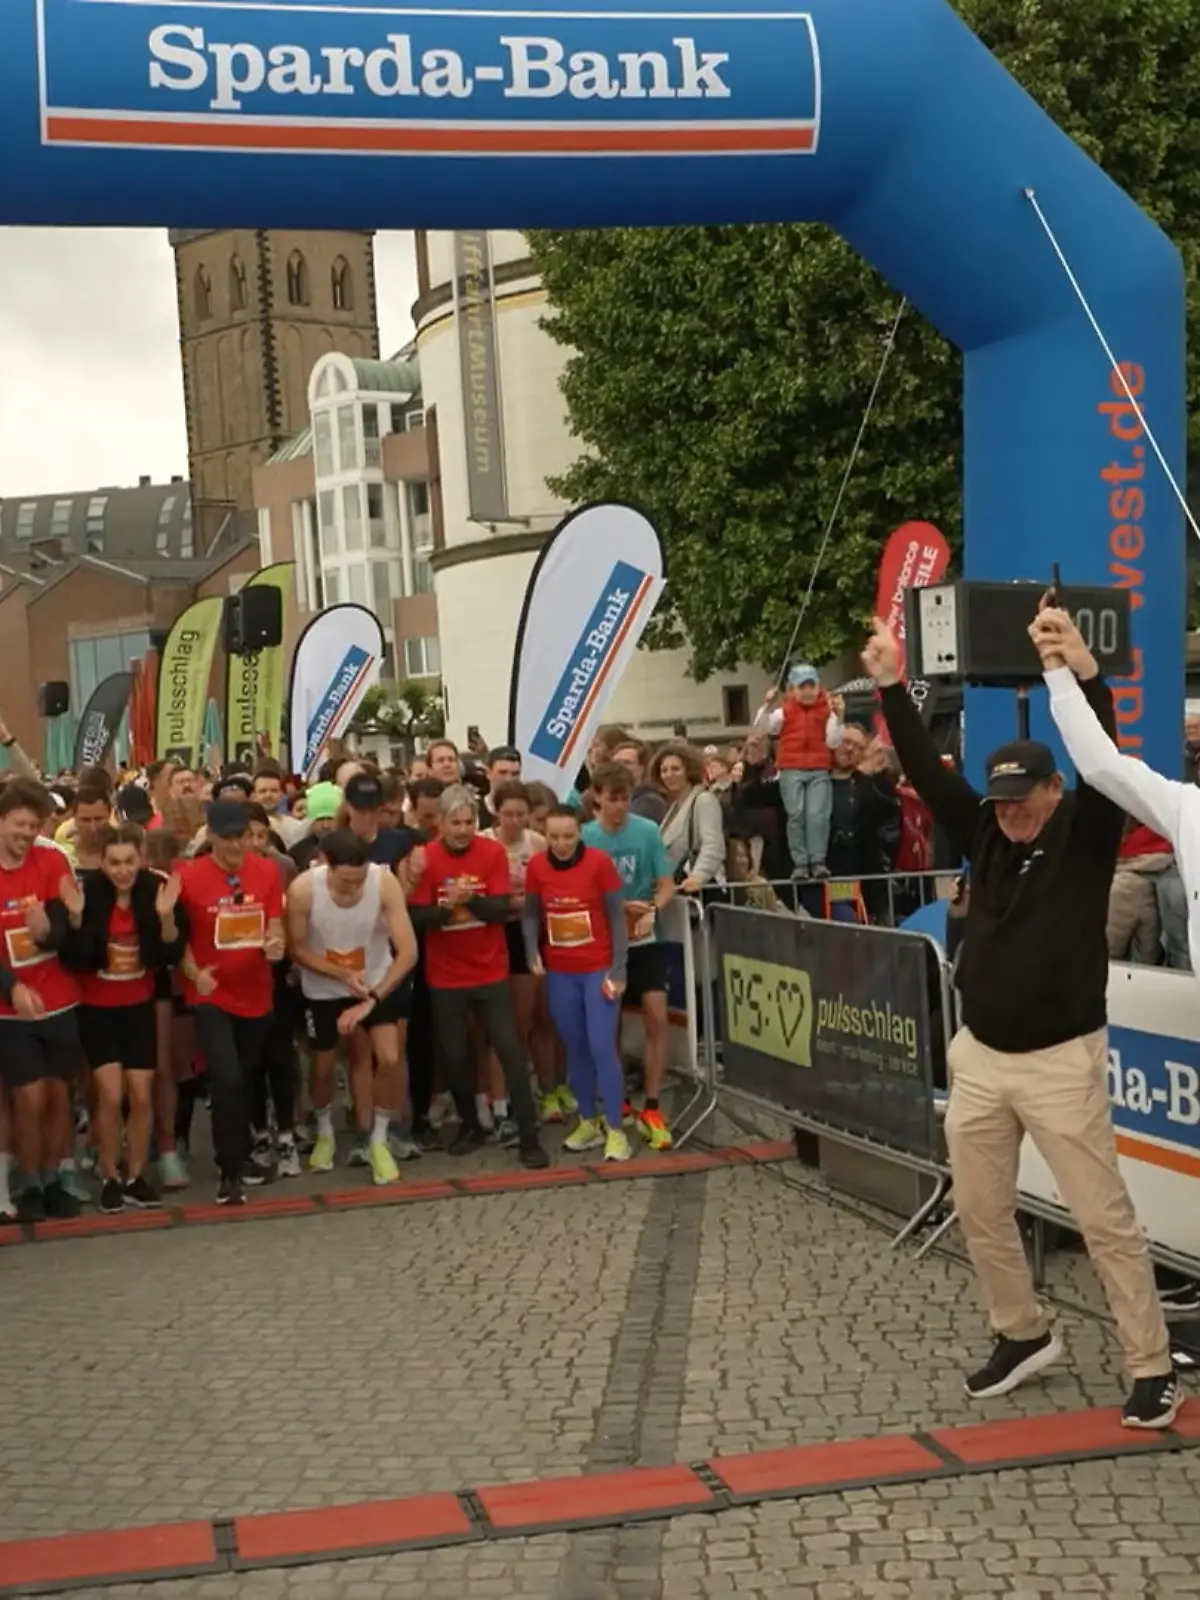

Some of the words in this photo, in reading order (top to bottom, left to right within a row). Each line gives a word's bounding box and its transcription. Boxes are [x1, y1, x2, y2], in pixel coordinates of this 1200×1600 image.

[148, 24, 732, 110] Sparda-Bank
[167, 630, 199, 743] pulsschlag
[547, 588, 630, 739] Sparda-Bank
[816, 992, 919, 1059] pulsschlag
